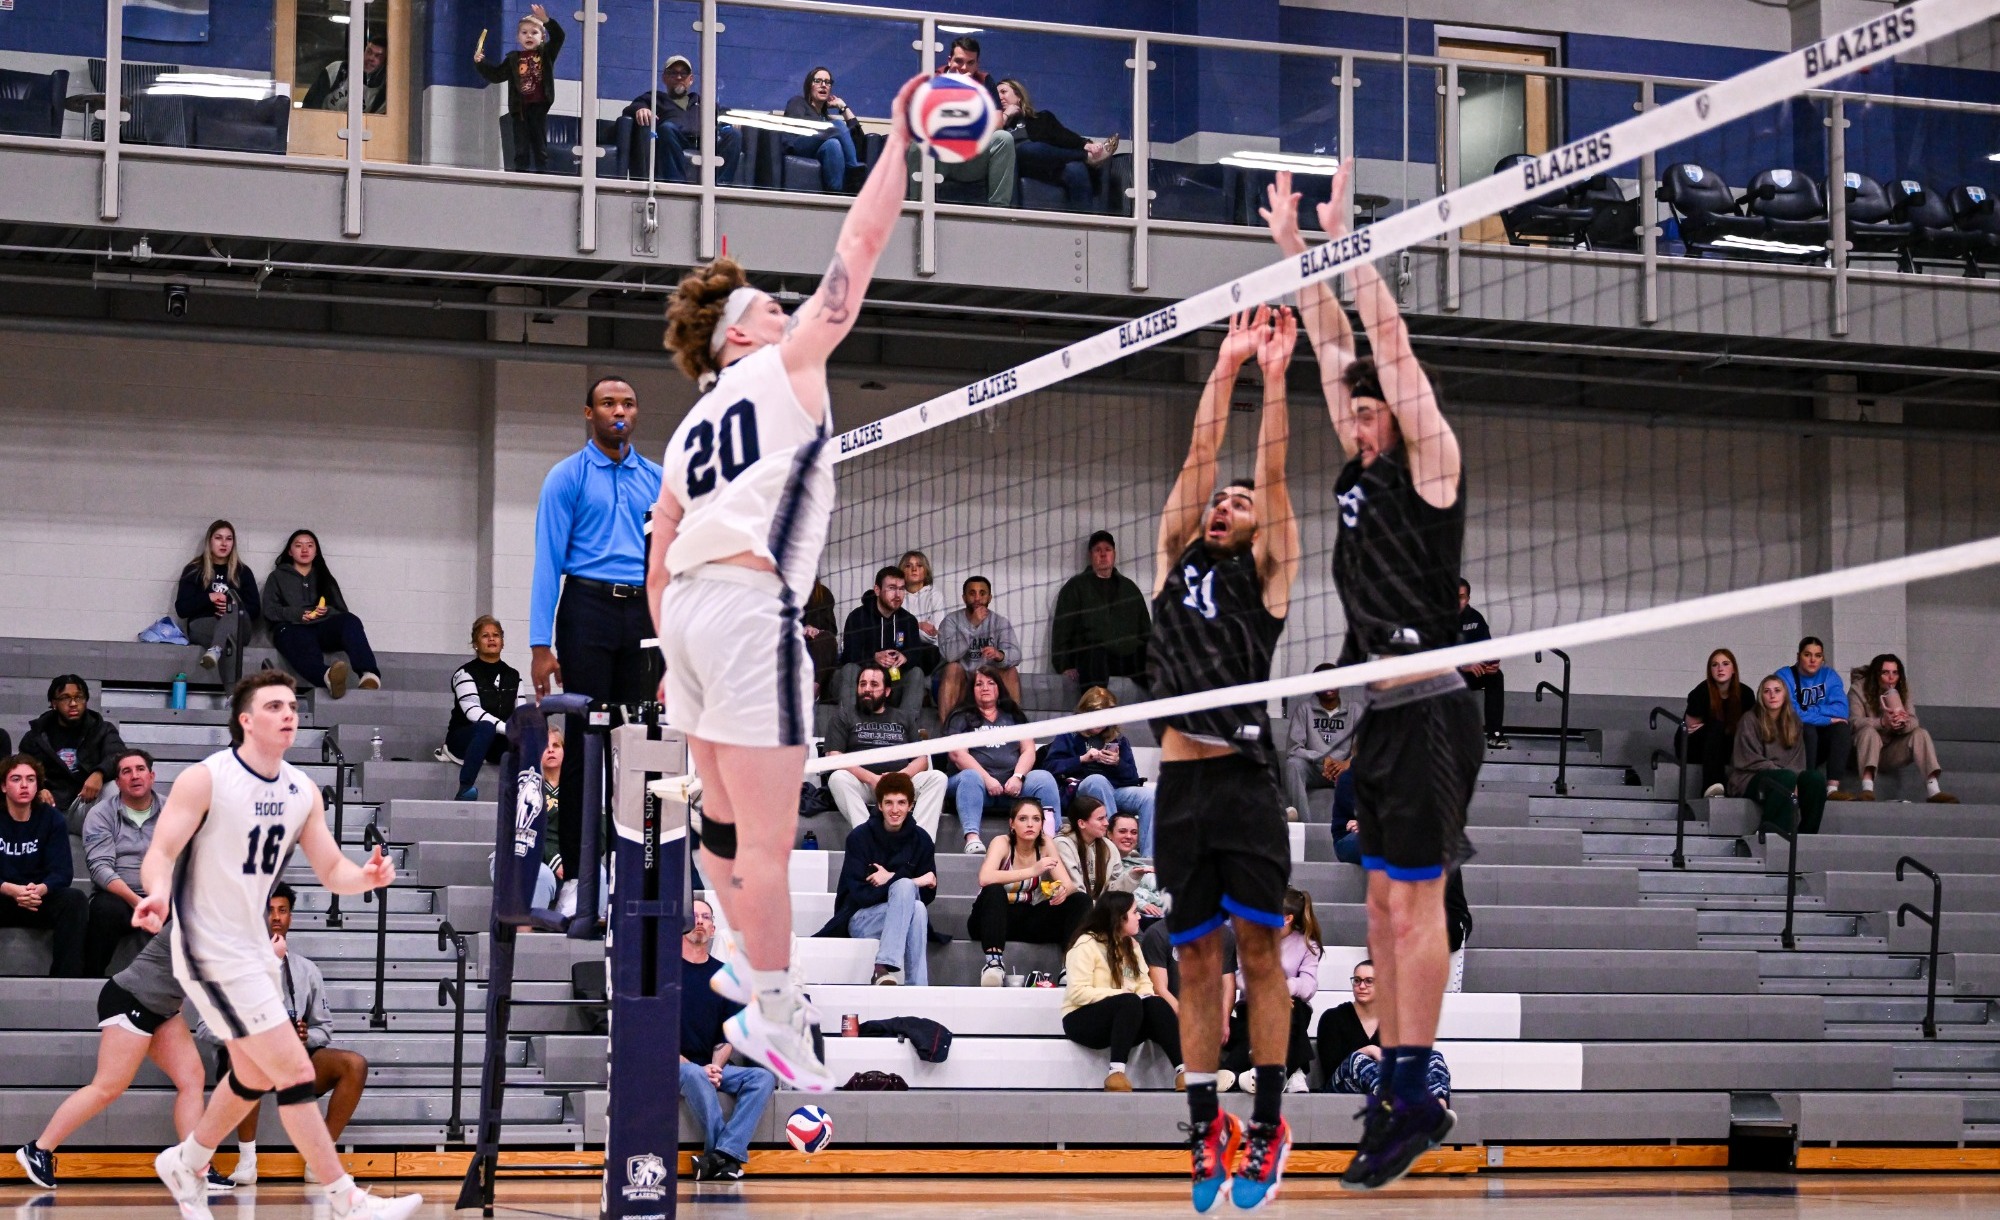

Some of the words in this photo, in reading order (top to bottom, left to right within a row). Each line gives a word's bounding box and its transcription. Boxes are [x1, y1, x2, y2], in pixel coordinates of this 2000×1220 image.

[1804, 6, 1916, 78] BLAZERS
[1523, 133, 1612, 190] BLAZERS
[1300, 230, 1371, 278] BLAZERS
[1119, 307, 1178, 348] BLAZERS
[967, 370, 1018, 406] BLAZERS
[683, 398, 761, 500] 20
[840, 421, 883, 453] BLAZERS
[242, 823, 285, 875] 16
